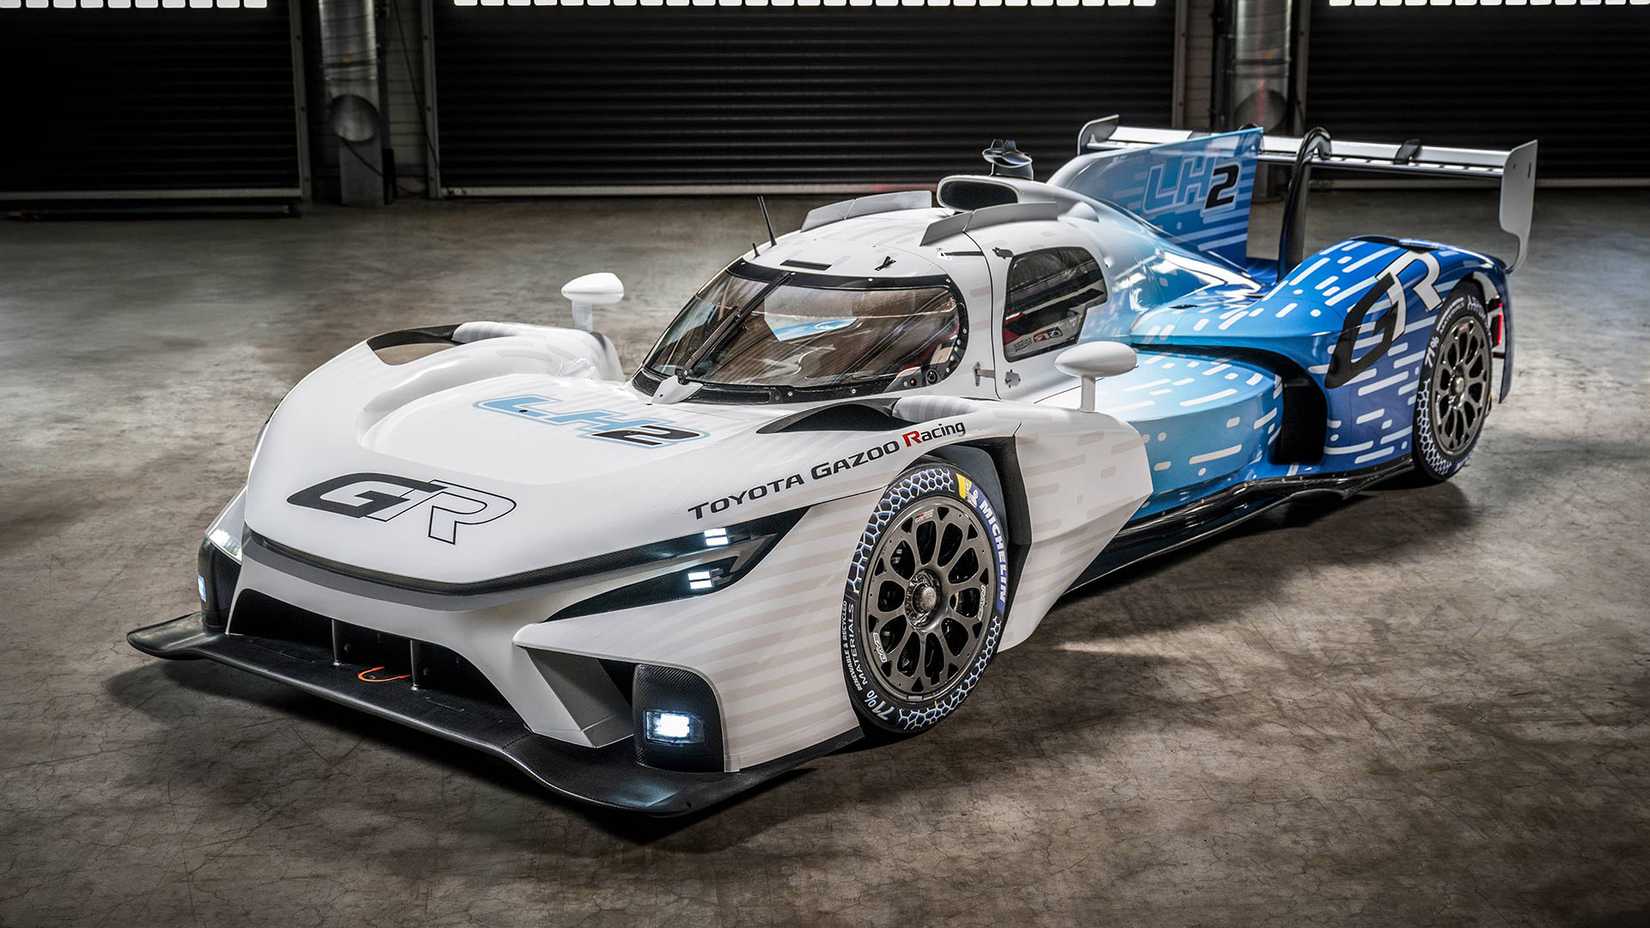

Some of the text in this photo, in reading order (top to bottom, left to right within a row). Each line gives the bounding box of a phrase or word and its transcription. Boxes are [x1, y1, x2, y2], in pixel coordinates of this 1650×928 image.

[1143, 157, 1240, 213] LH2
[1325, 249, 1442, 389] GR
[473, 394, 711, 449] LH2
[286, 472, 517, 545] GR
[688, 422, 966, 520] TOYOTA GAZOO Racing
[980, 499, 1008, 605] MICHELIN
[848, 603, 868, 685] MATERIALS
[864, 689, 895, 720] 71%
